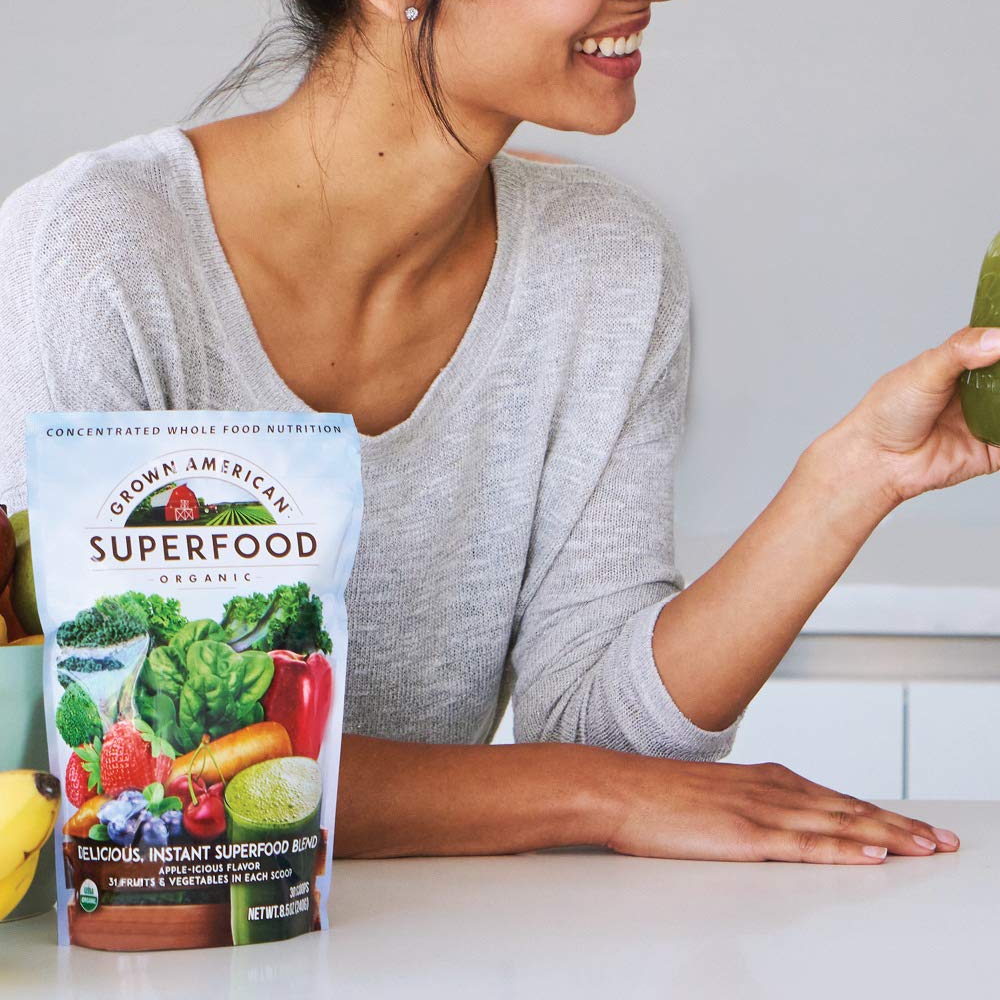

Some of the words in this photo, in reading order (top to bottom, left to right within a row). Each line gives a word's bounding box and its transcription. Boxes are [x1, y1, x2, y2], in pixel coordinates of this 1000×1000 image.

[46, 426, 161, 437] CONCENTRATED
[167, 425, 216, 435] WHOLE
[223, 424, 261, 434] FOOD
[267, 424, 342, 434] NUTRITION
[110, 460, 177, 516] GROWN
[185, 457, 290, 514] AMERICAN
[89, 531, 318, 563] SUPERFOOD
[159, 573, 252, 584] ORGANIC
[149, 846, 211, 862] INSTANT
[215, 840, 289, 860] SUPERFOOD
[292, 835, 318, 853] BLEND
[158, 863, 224, 875] APPLE-ICIOUS
[226, 861, 261, 872] FLAVOR
[121, 877, 156, 887] FRUITS
[159, 877, 166, 887] &
[169, 874, 229, 887] VEGETABLES
[231, 873, 242, 884] IN
[244, 871, 268, 882] EACH
[248, 907, 266, 920] NET
